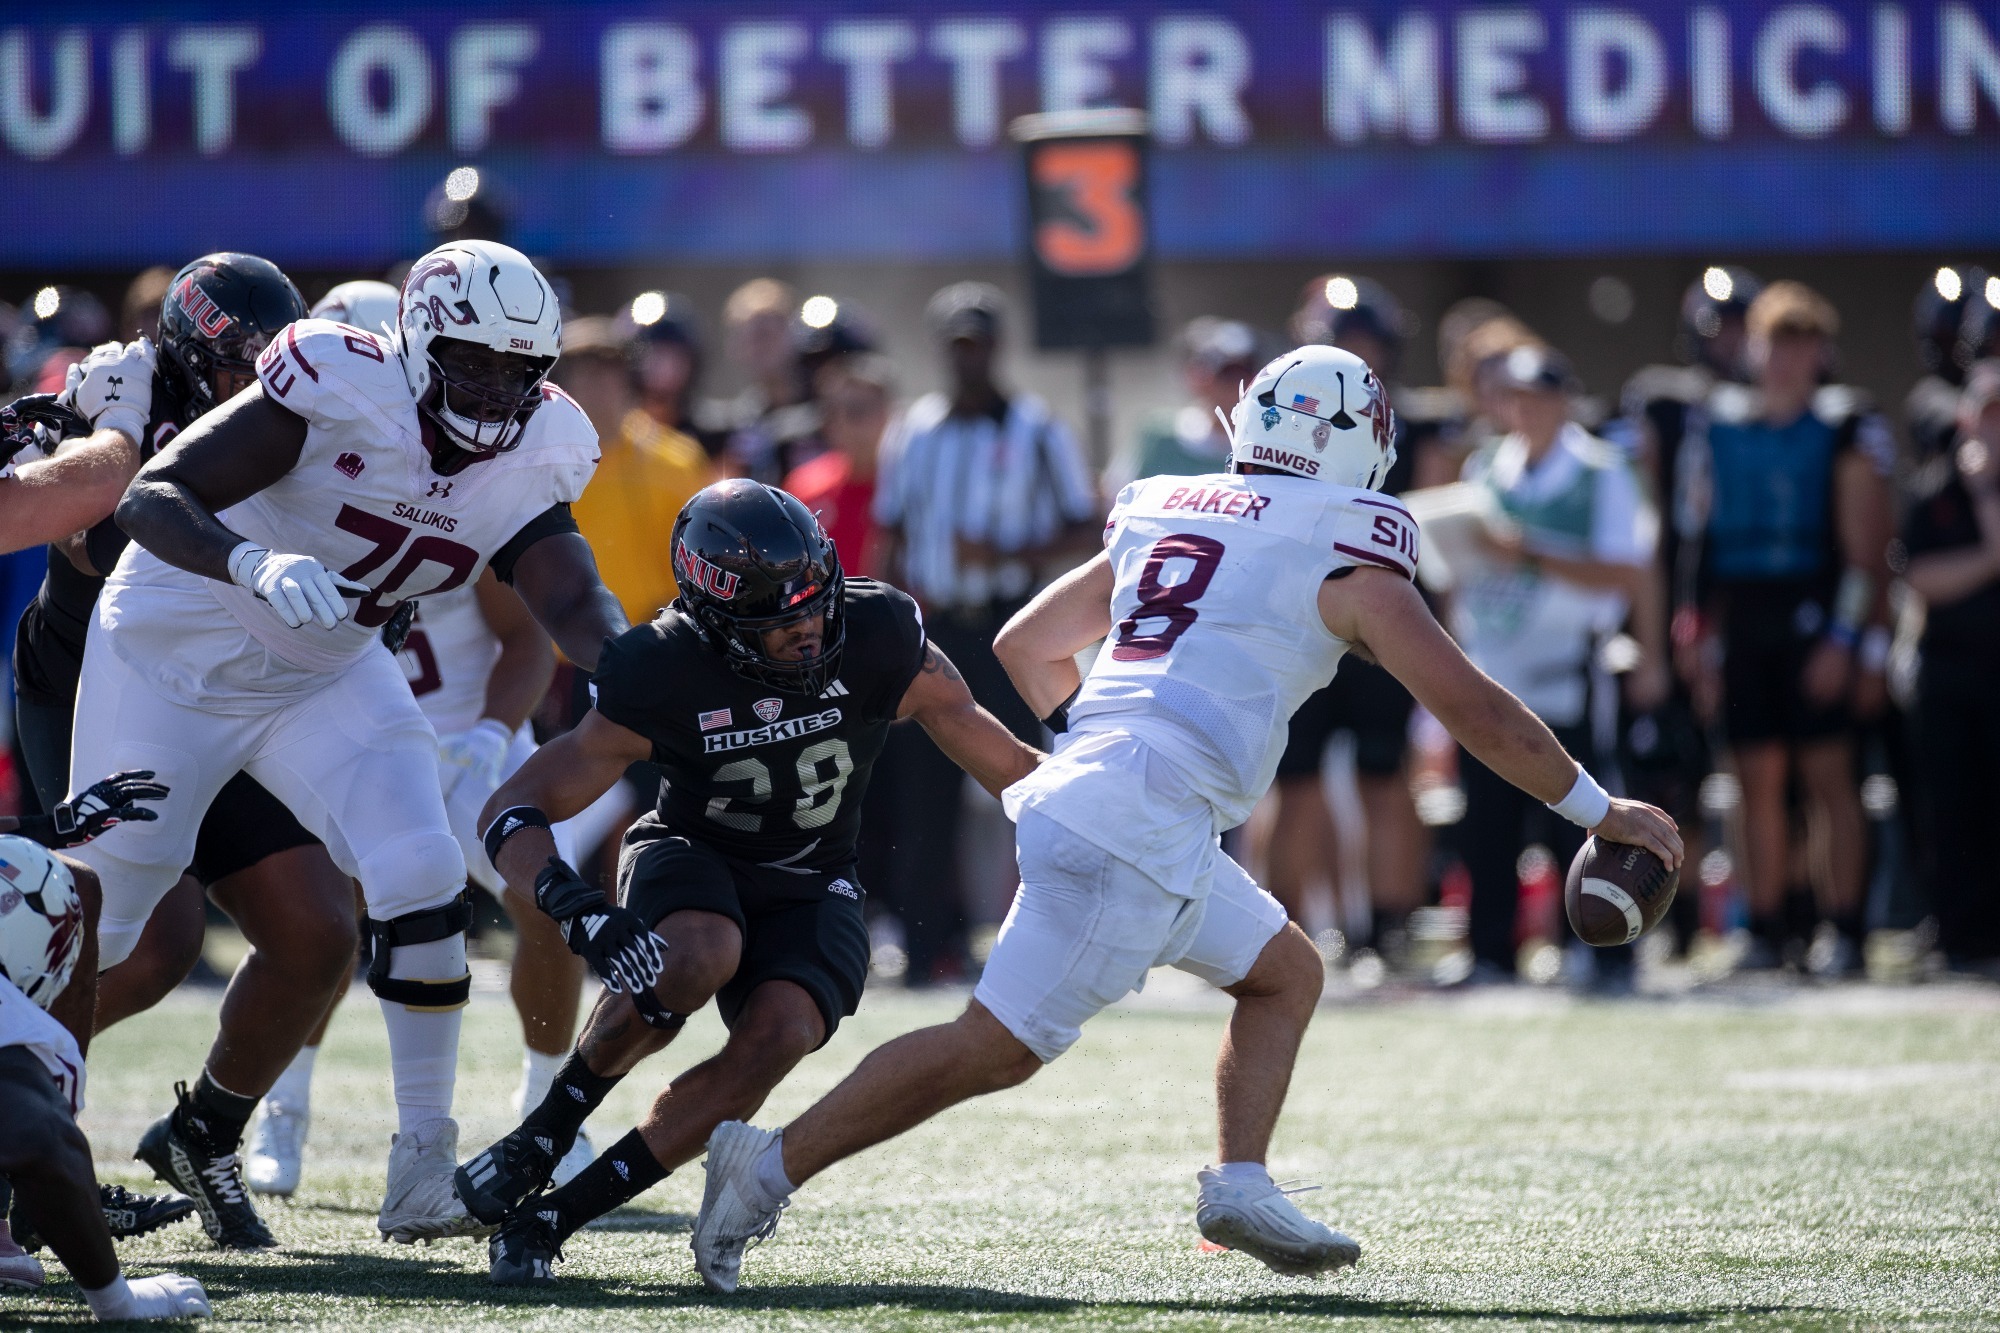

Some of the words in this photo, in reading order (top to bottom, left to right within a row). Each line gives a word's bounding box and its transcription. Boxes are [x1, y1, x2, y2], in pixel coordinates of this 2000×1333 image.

[327, 22, 542, 157] OF
[602, 17, 1252, 155] BETTER
[1032, 140, 1144, 276] 3
[172, 273, 233, 339] NIU
[261, 338, 296, 398] SIU
[510, 338, 534, 350] SIU
[1252, 445, 1320, 476] DAWGS
[392, 502, 458, 533] SALUKIS
[1162, 486, 1271, 522] BAKER
[334, 502, 480, 628] 70
[1371, 515, 1419, 567] SIU
[674, 537, 741, 601] NIU
[1112, 533, 1225, 661] 8
[706, 709, 842, 752] HUSKIES
[828, 882, 858, 900] adidas
[536, 1211, 558, 1230] adias
